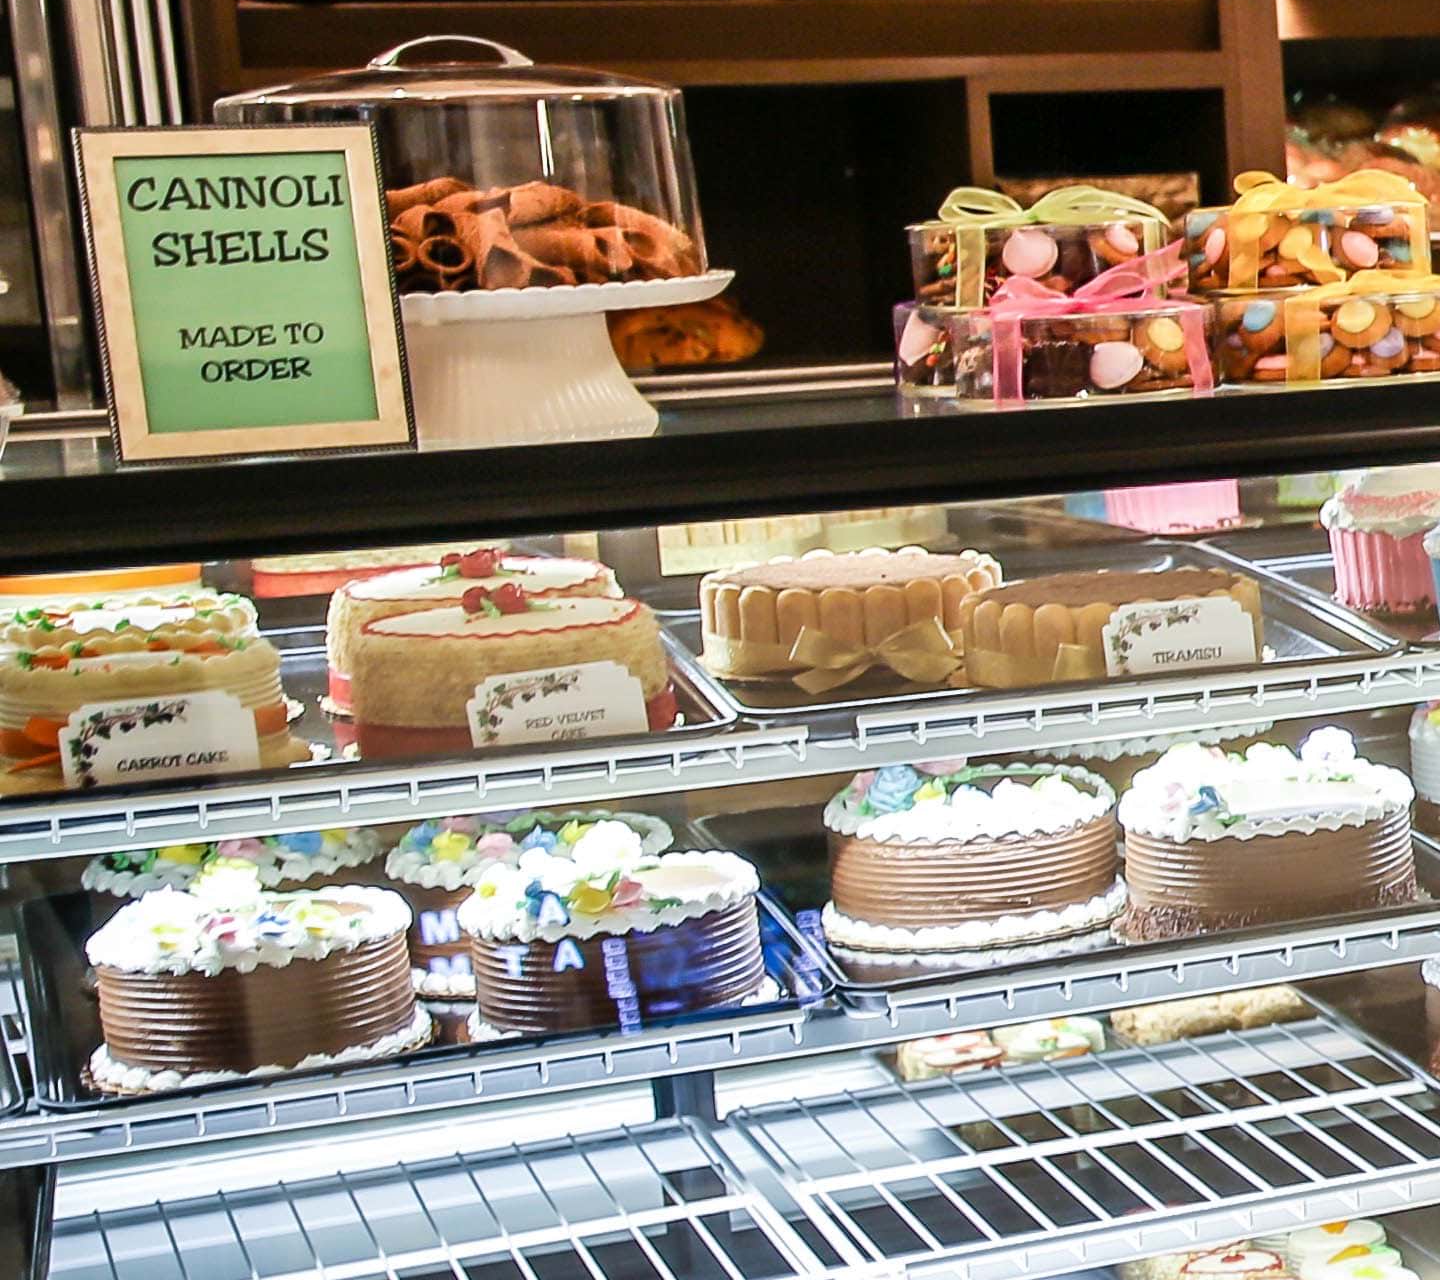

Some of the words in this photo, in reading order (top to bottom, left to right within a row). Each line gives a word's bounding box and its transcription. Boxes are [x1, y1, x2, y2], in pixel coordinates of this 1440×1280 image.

[126, 174, 345, 212] CANNOLI
[151, 227, 330, 268] SHELLS
[178, 324, 277, 350] MADE
[283, 322, 325, 345] TO
[200, 357, 312, 383] ORDER
[1152, 646, 1223, 665] TIRAMISU
[524, 717, 553, 730] RED
[556, 708, 606, 725] VELVET
[116, 753, 182, 772] CARROT
[185, 749, 230, 766] CAKE
